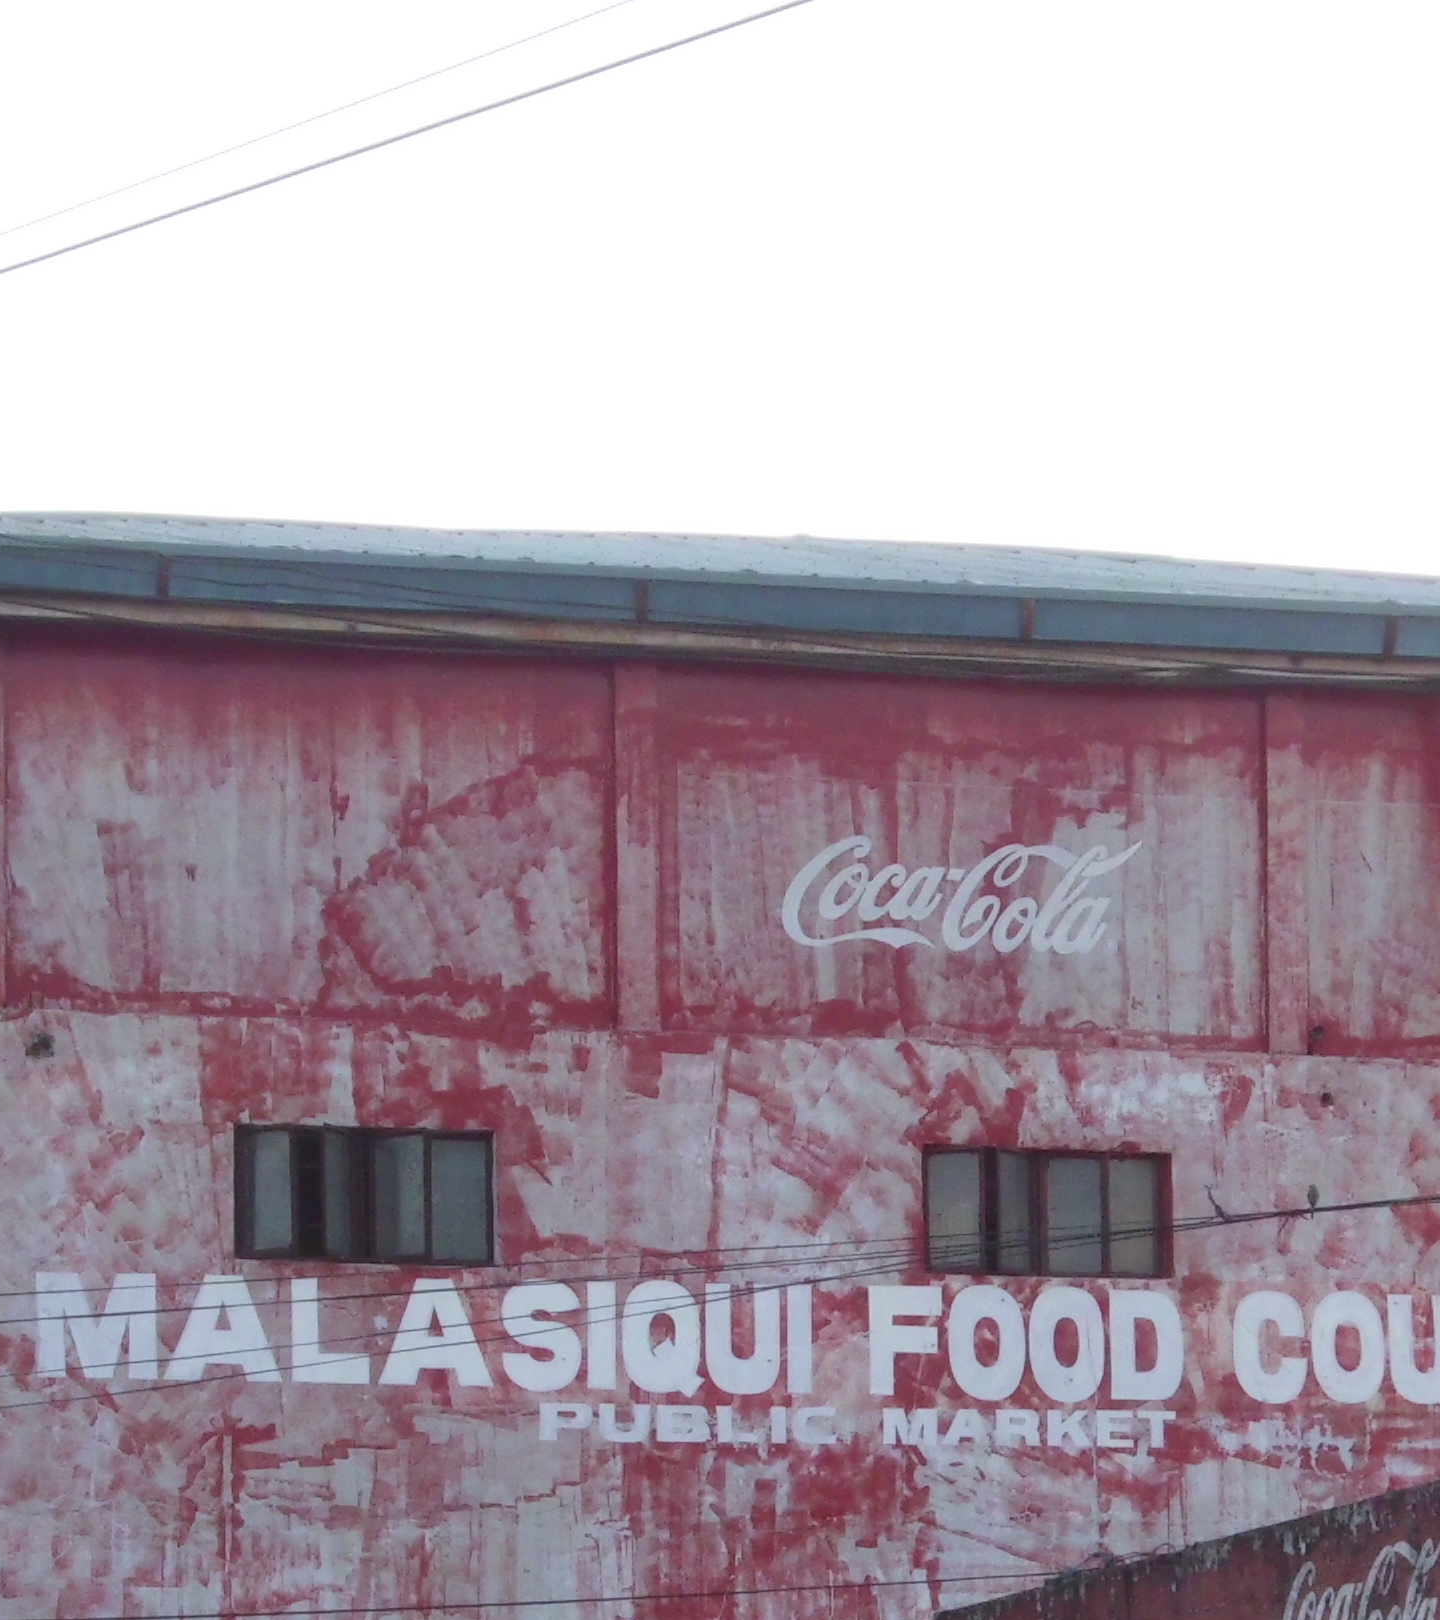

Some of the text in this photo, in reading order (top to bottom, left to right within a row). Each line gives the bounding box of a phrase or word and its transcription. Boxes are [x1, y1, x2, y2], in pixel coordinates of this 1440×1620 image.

[782, 834, 1143, 954] Coca-Cola
[34, 1271, 812, 1397] MALASIQUI
[867, 1284, 1185, 1402] FOOD
[538, 1402, 1177, 1449] PUBLIC MARKET
